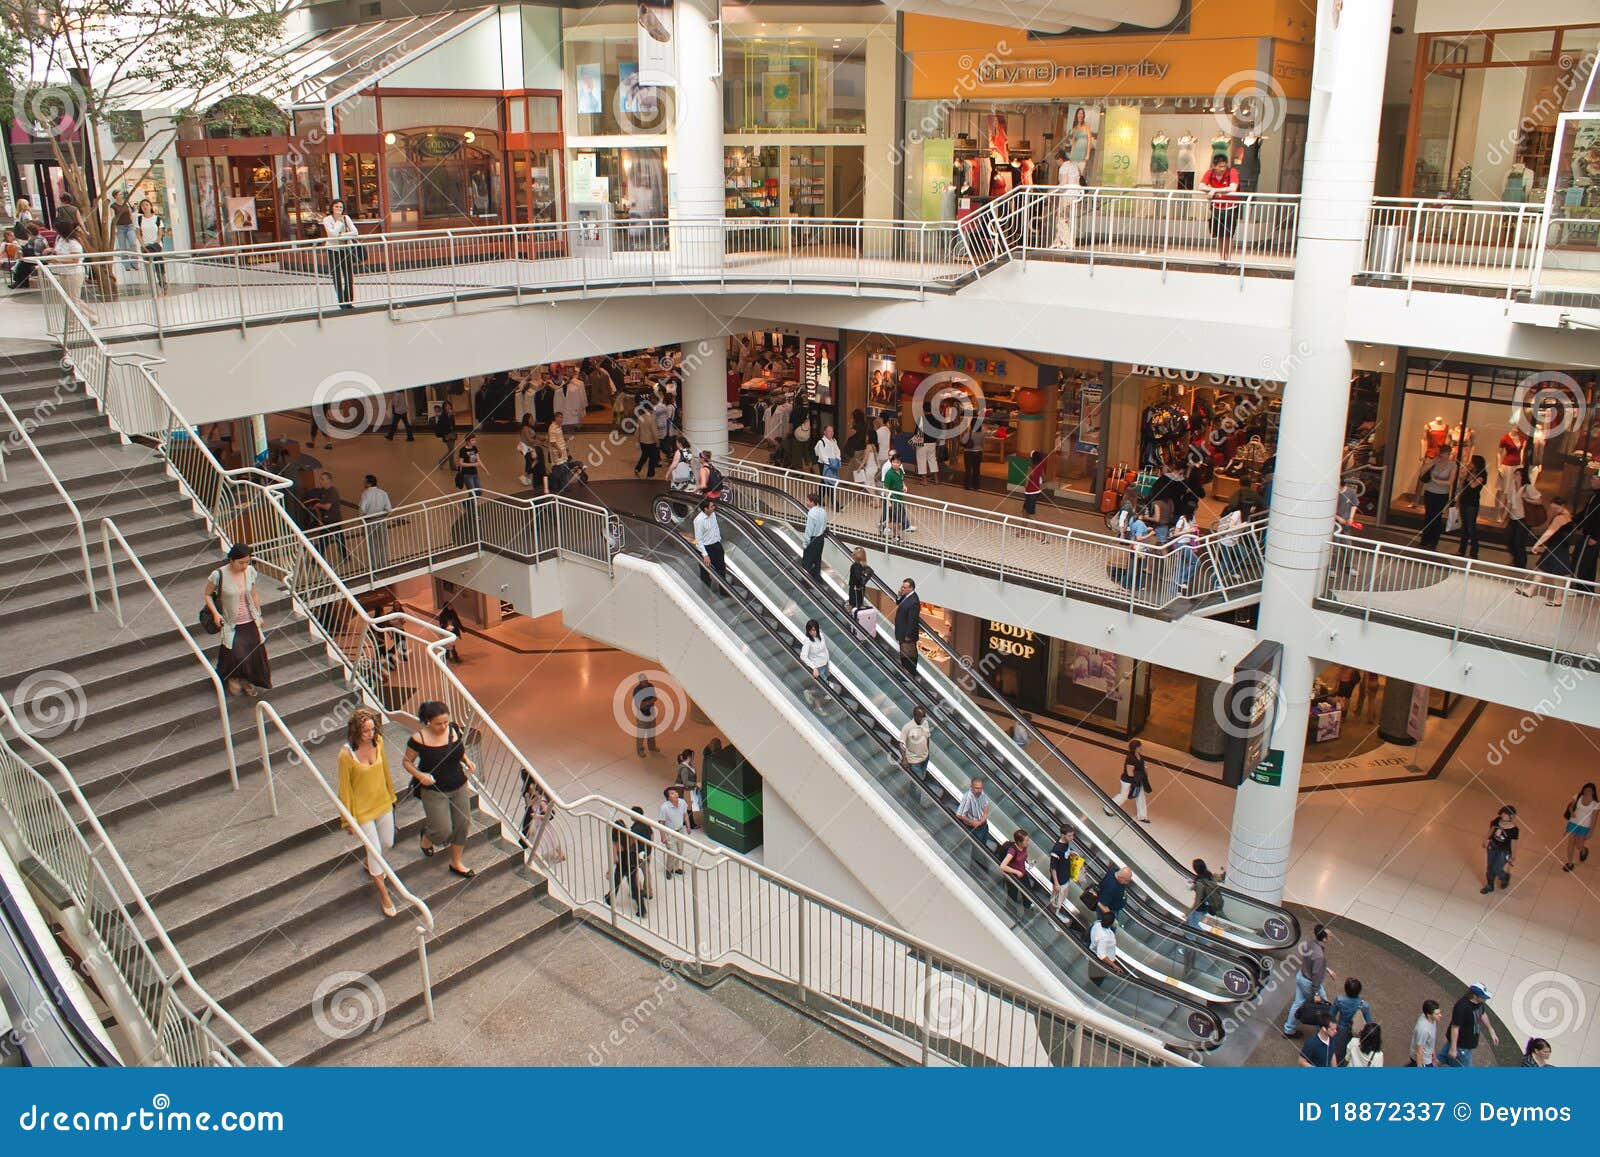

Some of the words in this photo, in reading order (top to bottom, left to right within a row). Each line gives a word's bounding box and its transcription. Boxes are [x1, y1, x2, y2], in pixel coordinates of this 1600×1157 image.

[1055, 61, 1169, 80] maternity
[1112, 154, 1131, 170] 39
[805, 343, 816, 401] FIORUCCI
[722, 492, 728, 502] 2
[661, 510, 667, 521] 2
[989, 620, 1035, 642] BODY
[989, 636, 1035, 659] SHOP
[1273, 928, 1279, 938] 1
[1233, 981, 1239, 991] 1
[1198, 1024, 1204, 1034] 1
